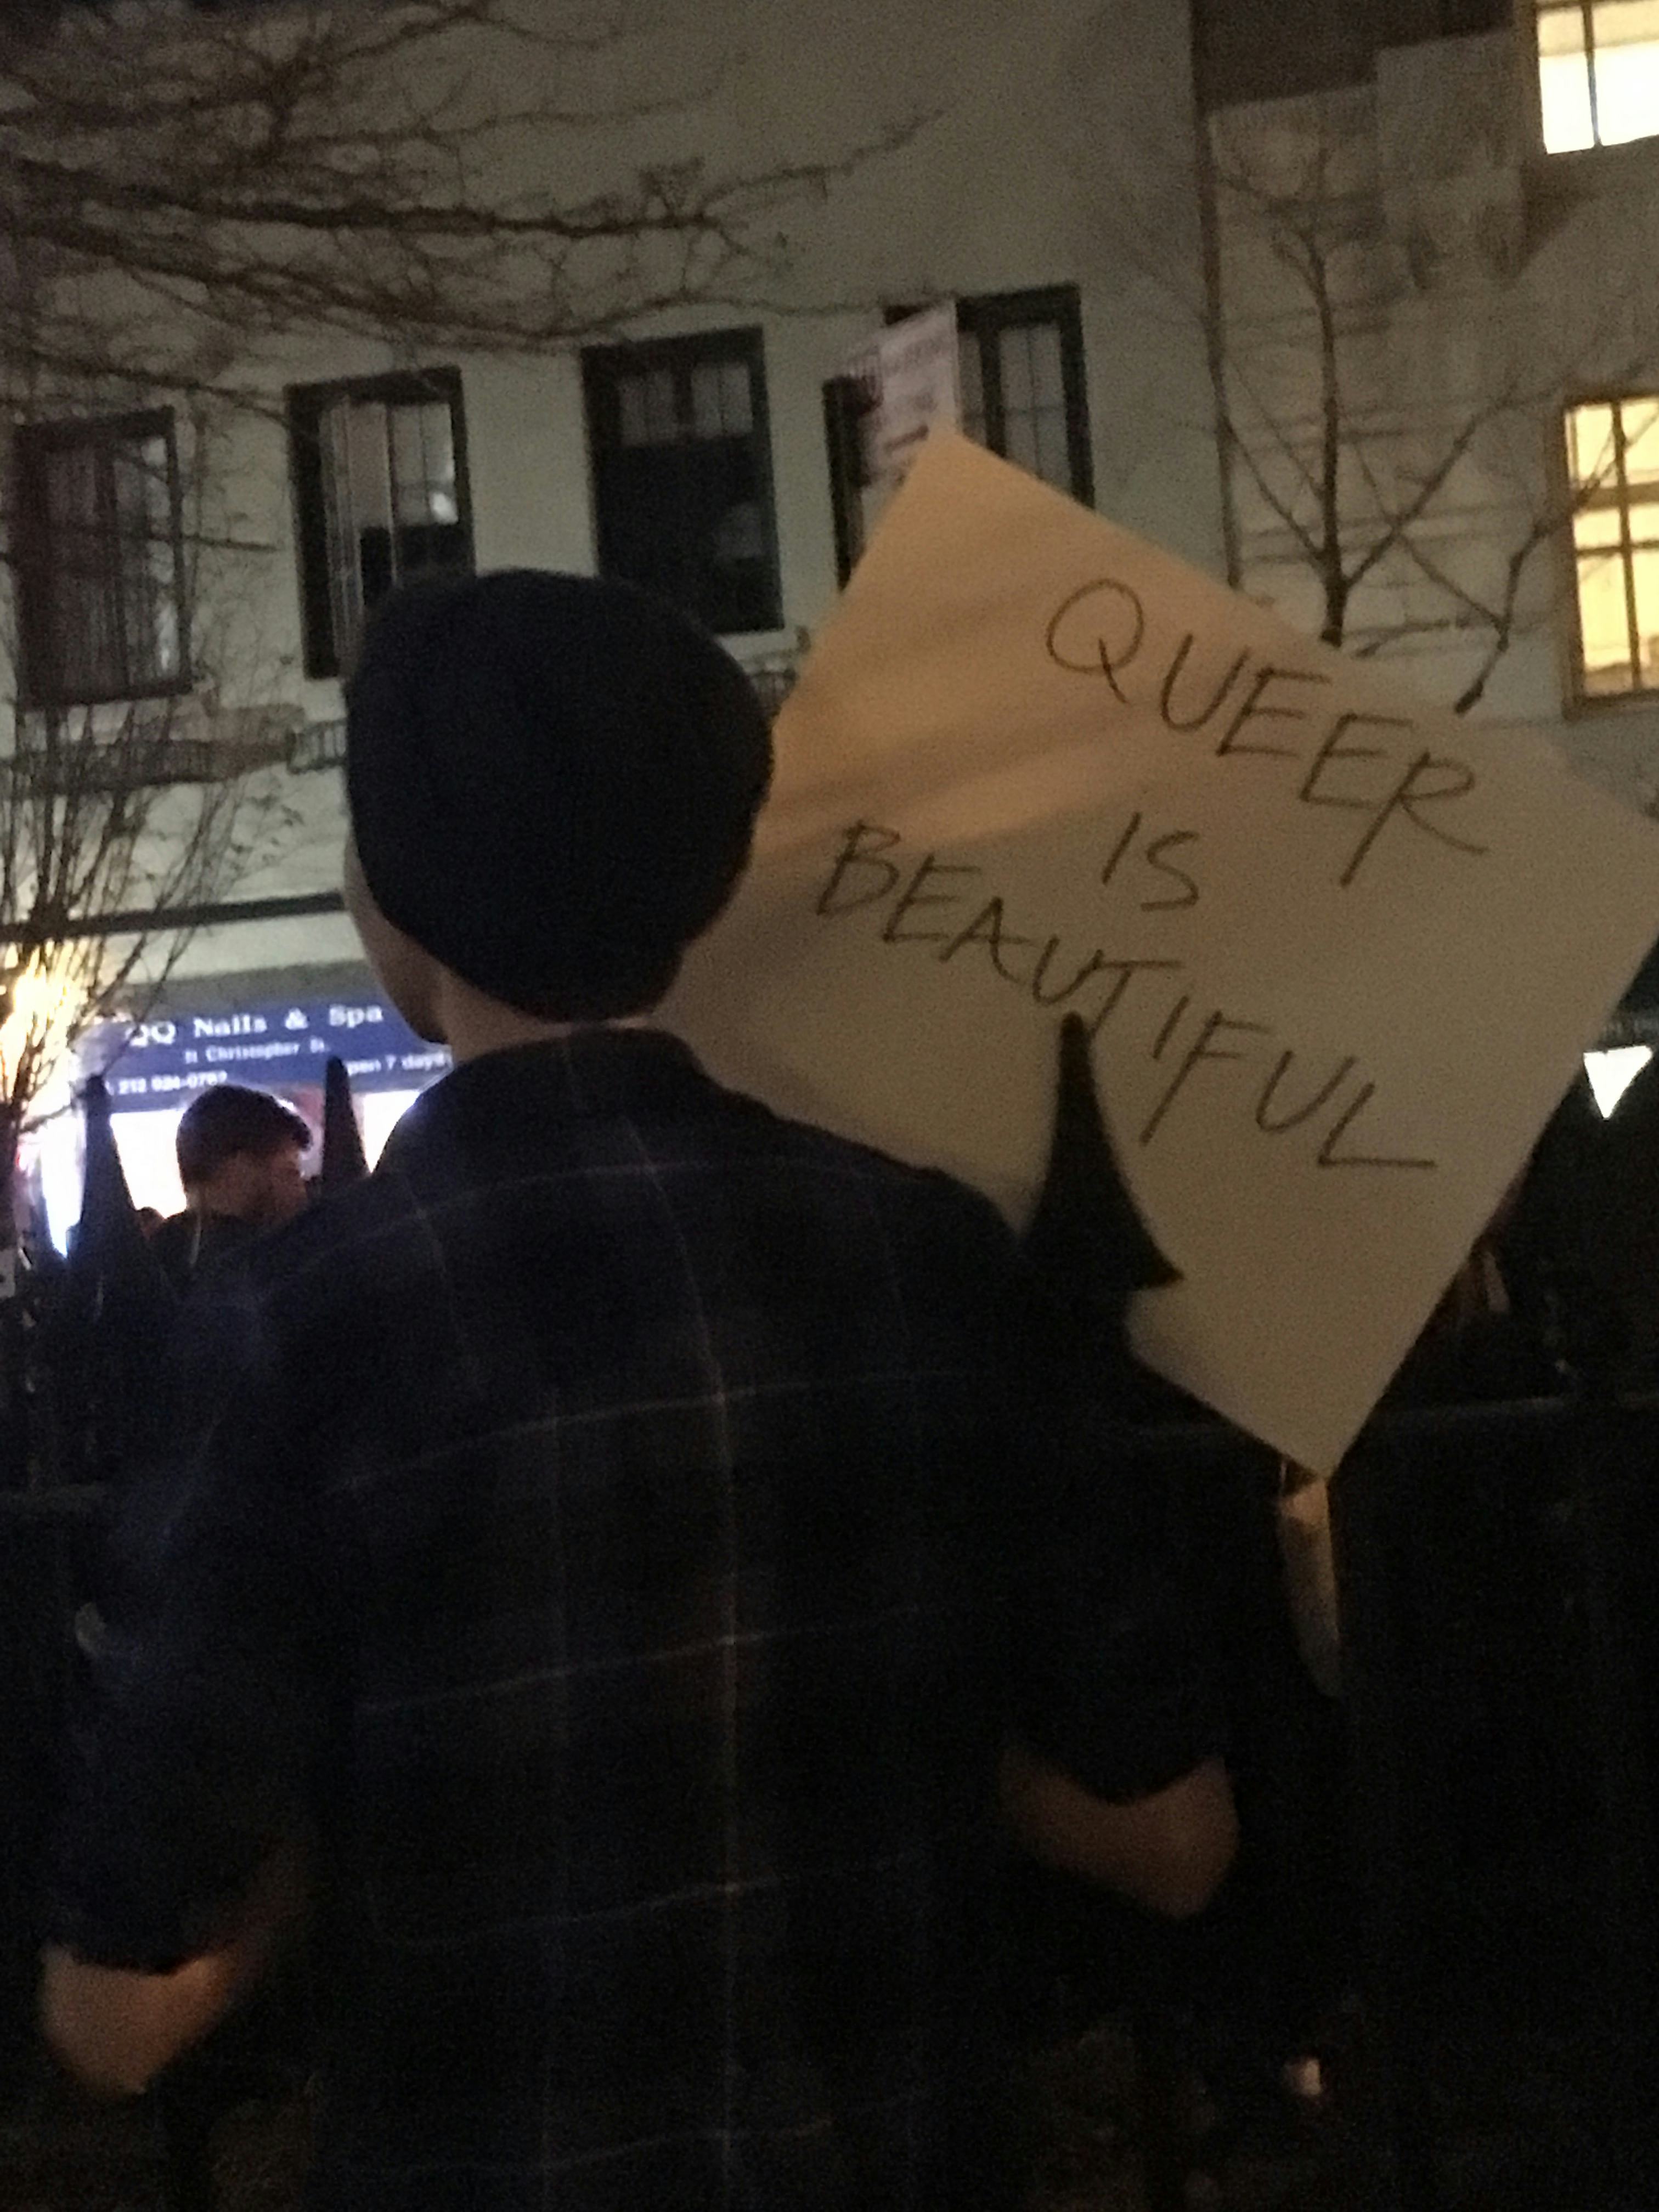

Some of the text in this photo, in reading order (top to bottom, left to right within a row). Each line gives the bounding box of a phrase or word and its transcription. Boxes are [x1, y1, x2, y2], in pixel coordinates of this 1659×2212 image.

[1045, 577, 1489, 888] QUEER
[1100, 810, 1201, 913] IS
[193, 1014, 268, 1038] Nails
[284, 1007, 309, 1031] &
[329, 1004, 383, 1029] Spa
[815, 819, 1436, 1167] BEAUTIFUL
[205, 1041, 301, 1063] Christopher
[344, 1058, 382, 1077] pen
[386, 1054, 397, 1070] 7
